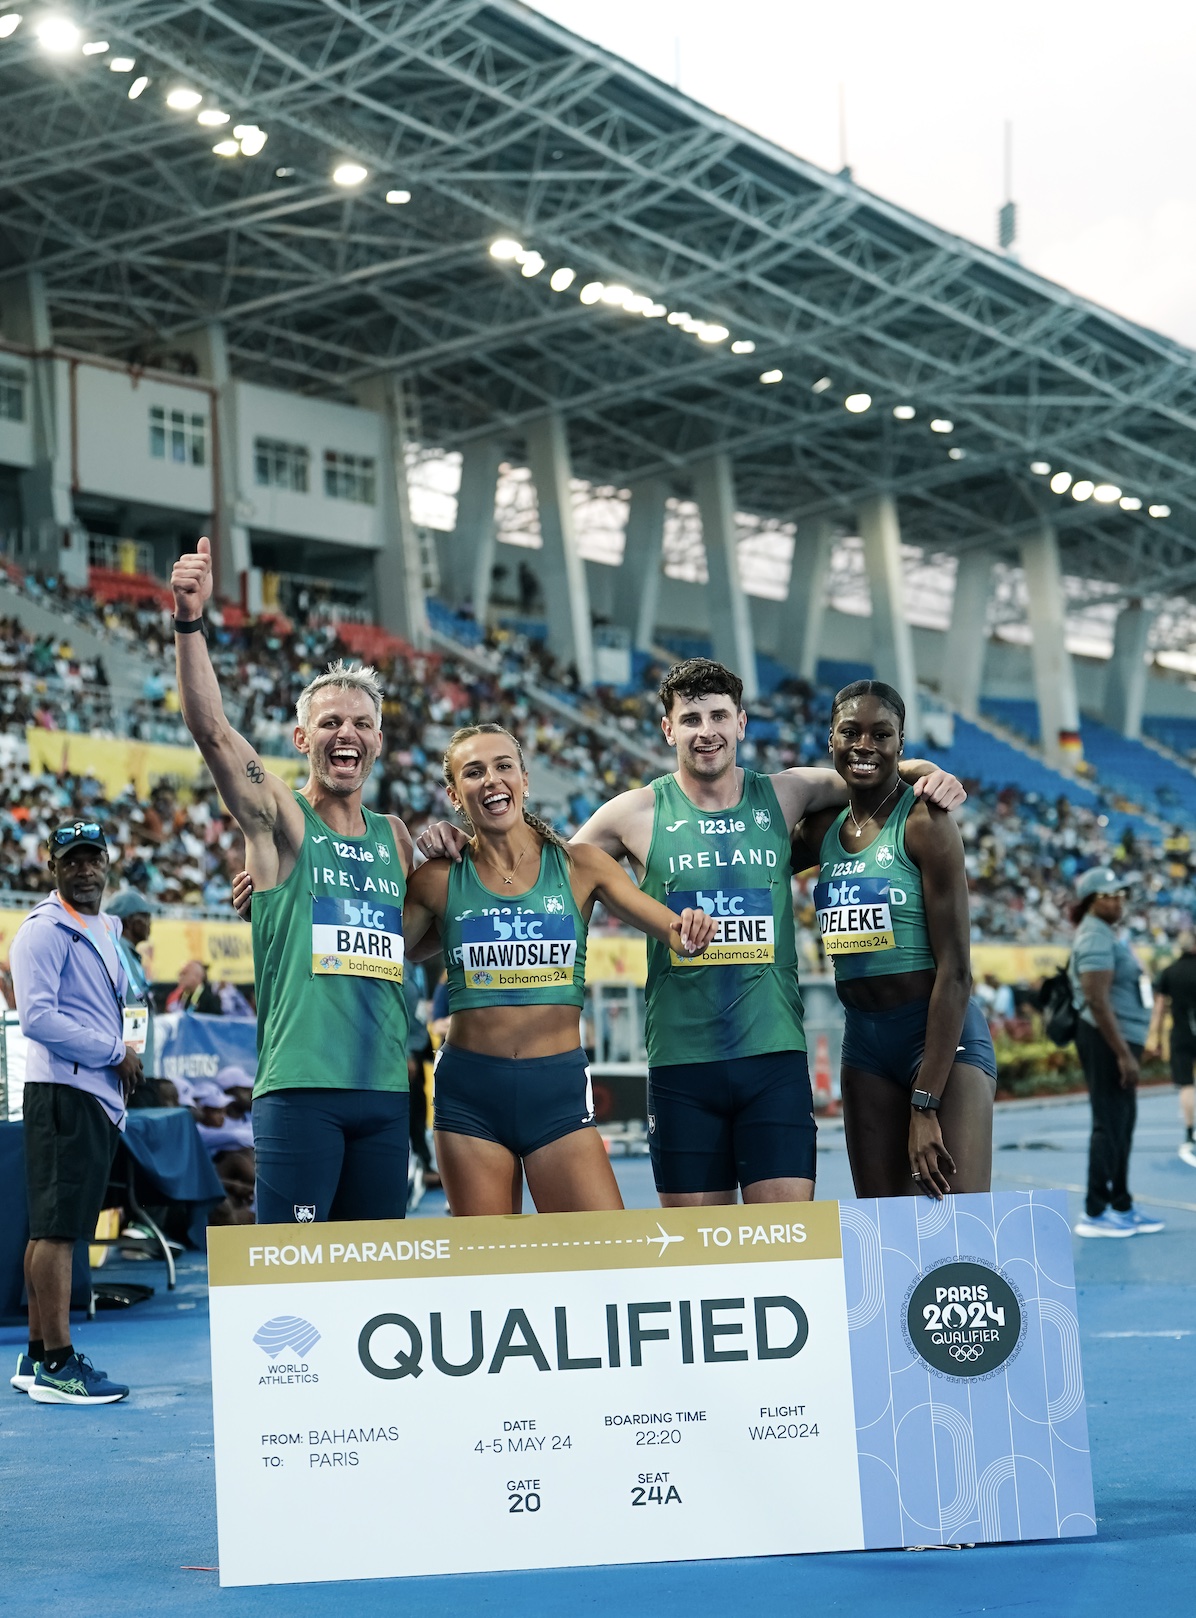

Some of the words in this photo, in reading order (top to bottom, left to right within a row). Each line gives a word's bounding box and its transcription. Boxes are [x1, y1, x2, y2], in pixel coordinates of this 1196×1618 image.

[698, 819, 746, 835] 123.ie
[333, 842, 375, 863] 123.ie
[669, 849, 777, 874] IRELAND
[831, 860, 866, 877] 123.ie
[313, 867, 400, 897] IRELAND
[696, 891, 745, 916] btc
[827, 881, 861, 907] btc
[344, 900, 385, 930] btc
[819, 907, 886, 935] DELEKE
[493, 916, 543, 940] btc
[710, 920, 767, 943] EENE
[337, 930, 392, 959] BARR
[469, 943, 571, 968] MAWDSLEY
[698, 1227, 731, 1247] TO
[739, 1223, 807, 1245] PARIS
[249, 1245, 322, 1266] FROM
[330, 1240, 450, 1263] PARADISE
[924, 1256, 953, 1274] OLYMPIC
[976, 1256, 995, 1269] PARIS
[935, 1284, 989, 1303] PARIS
[922, 1301, 1006, 1331] 2024
[358, 1296, 809, 1380] QUALIFIED
[931, 1329, 1000, 1345] QUALIFIER
[259, 1372, 319, 1385] ATHLETICS
[268, 1364, 310, 1376] WORLD
[605, 1413, 672, 1426] BOARDING
[676, 1411, 706, 1421] TIME
[761, 1406, 805, 1417] FLIGHT
[504, 1420, 536, 1431] DATE
[749, 1424, 819, 1440] WA2024
[262, 1434, 302, 1445] FROM:
[309, 1427, 399, 1444] BAHAMAS
[475, 1439, 502, 1453] 4-5
[509, 1437, 545, 1452] MAY
[552, 1436, 572, 1449] 24
[636, 1430, 681, 1445] 22:20
[262, 1457, 283, 1467] TO:
[310, 1452, 359, 1467] PARIS
[507, 1480, 540, 1491] GATE
[638, 1472, 669, 1483] SEAT
[508, 1493, 540, 1513] 20
[631, 1484, 682, 1507] 24A
